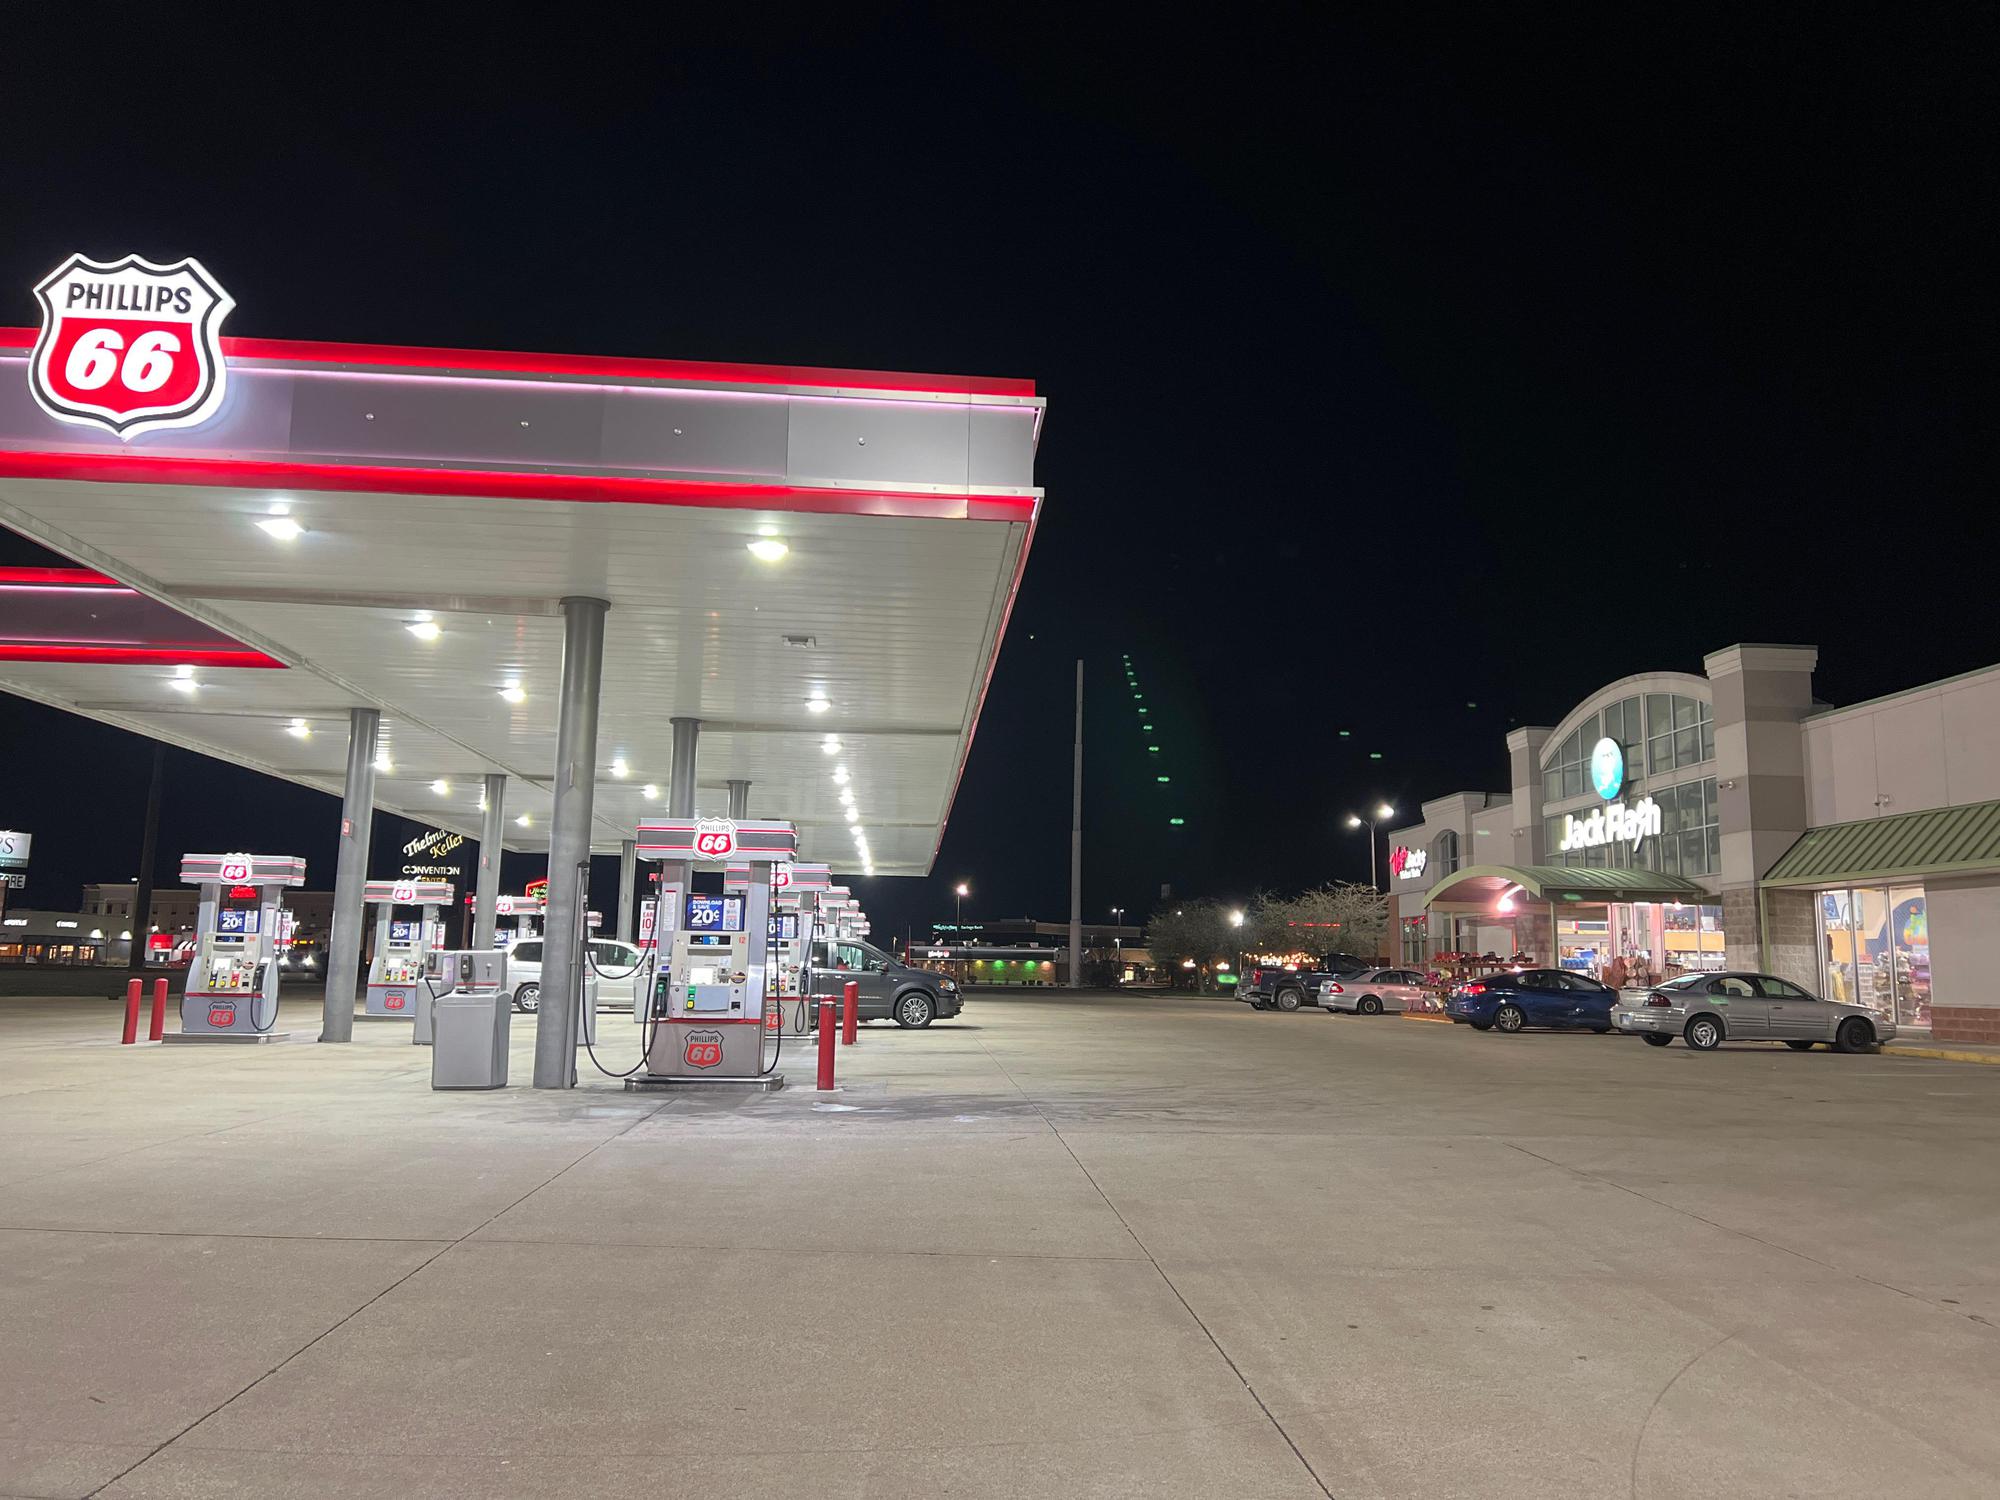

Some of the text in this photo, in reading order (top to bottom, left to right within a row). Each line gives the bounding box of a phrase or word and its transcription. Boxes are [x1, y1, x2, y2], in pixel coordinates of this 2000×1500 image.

[66, 282, 192, 314] PHILLIPS
[65, 328, 181, 392] 66
[701, 824, 730, 832] PHILLIPS
[1560, 808, 1606, 851] Jack
[402, 829, 448, 857] Thelma
[429, 834, 464, 859] Keller
[700, 835, 728, 851] 66
[225, 866, 245, 877] 66
[402, 865, 460, 875] CONVENTION
[212, 1013, 230, 1022] 66
[690, 1035, 719, 1043] PHILLIPS
[691, 1046, 716, 1061] 66
